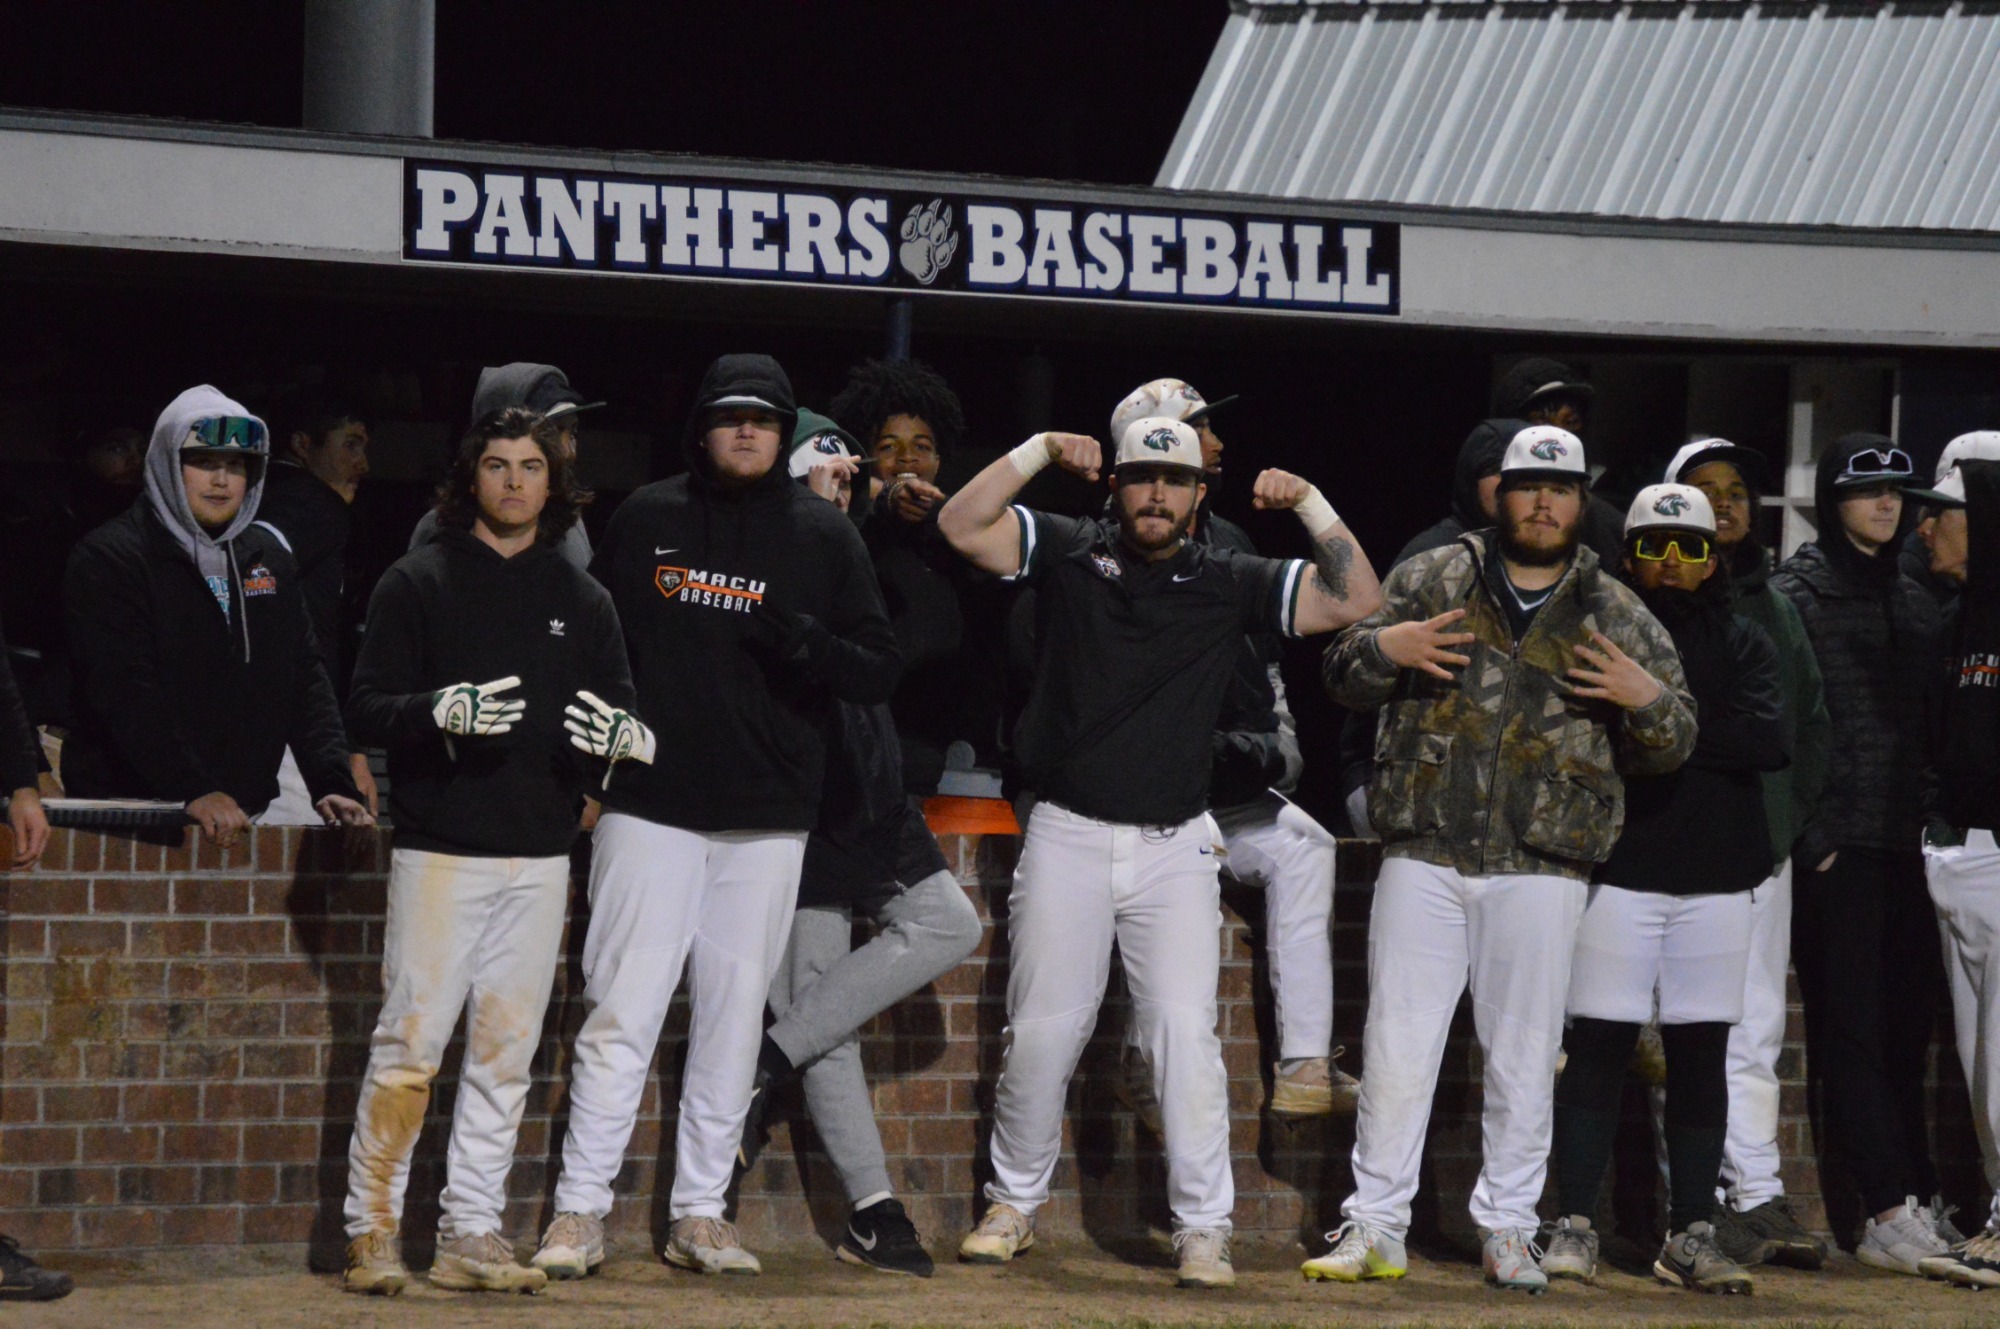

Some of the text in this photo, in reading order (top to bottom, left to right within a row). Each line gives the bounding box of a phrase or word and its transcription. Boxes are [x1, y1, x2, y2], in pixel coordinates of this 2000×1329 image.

[415, 168, 1390, 306] PANTHERS BASEBALL
[688, 569, 766, 594] MACU
[680, 587, 762, 614] BASEBAL
